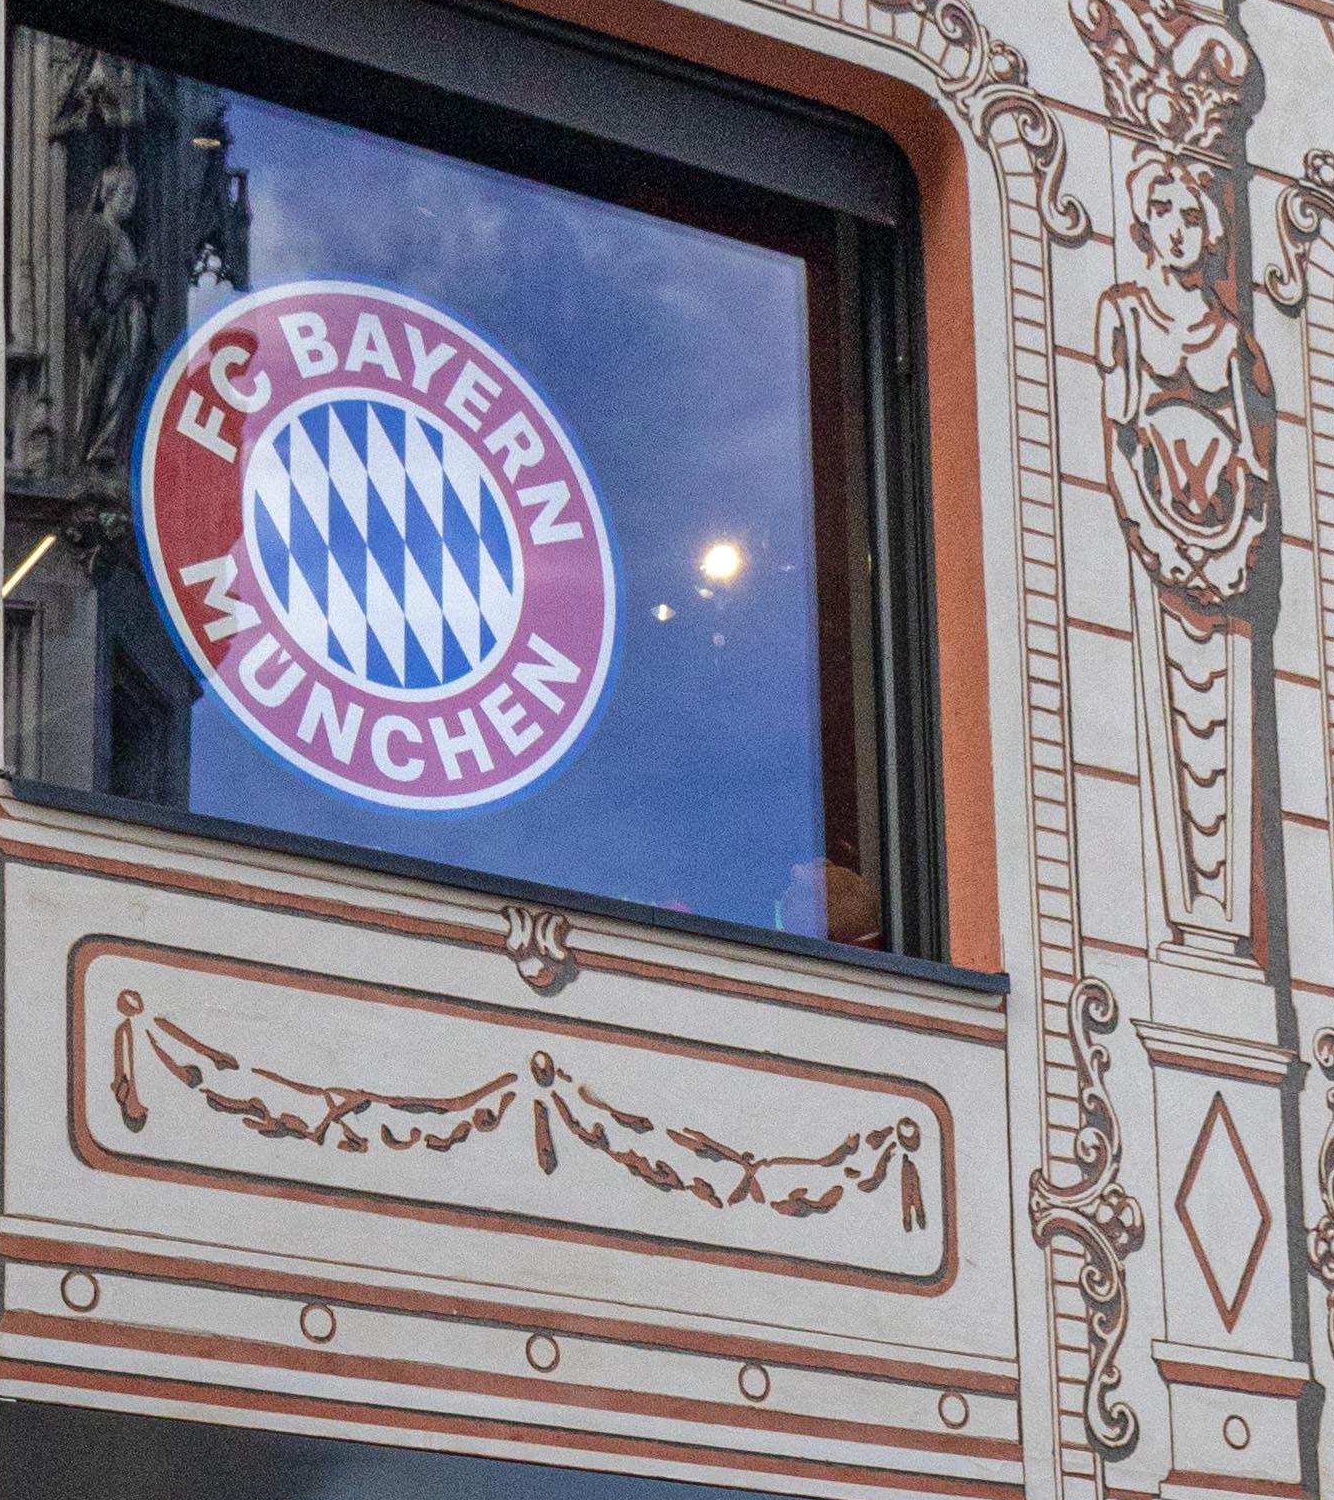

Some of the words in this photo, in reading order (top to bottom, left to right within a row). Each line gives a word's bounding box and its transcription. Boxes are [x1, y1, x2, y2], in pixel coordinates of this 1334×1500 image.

[176, 328, 272, 464] FC
[278, 311, 585, 547] BAYERN
[183, 553, 584, 783] MÜNCHEN
